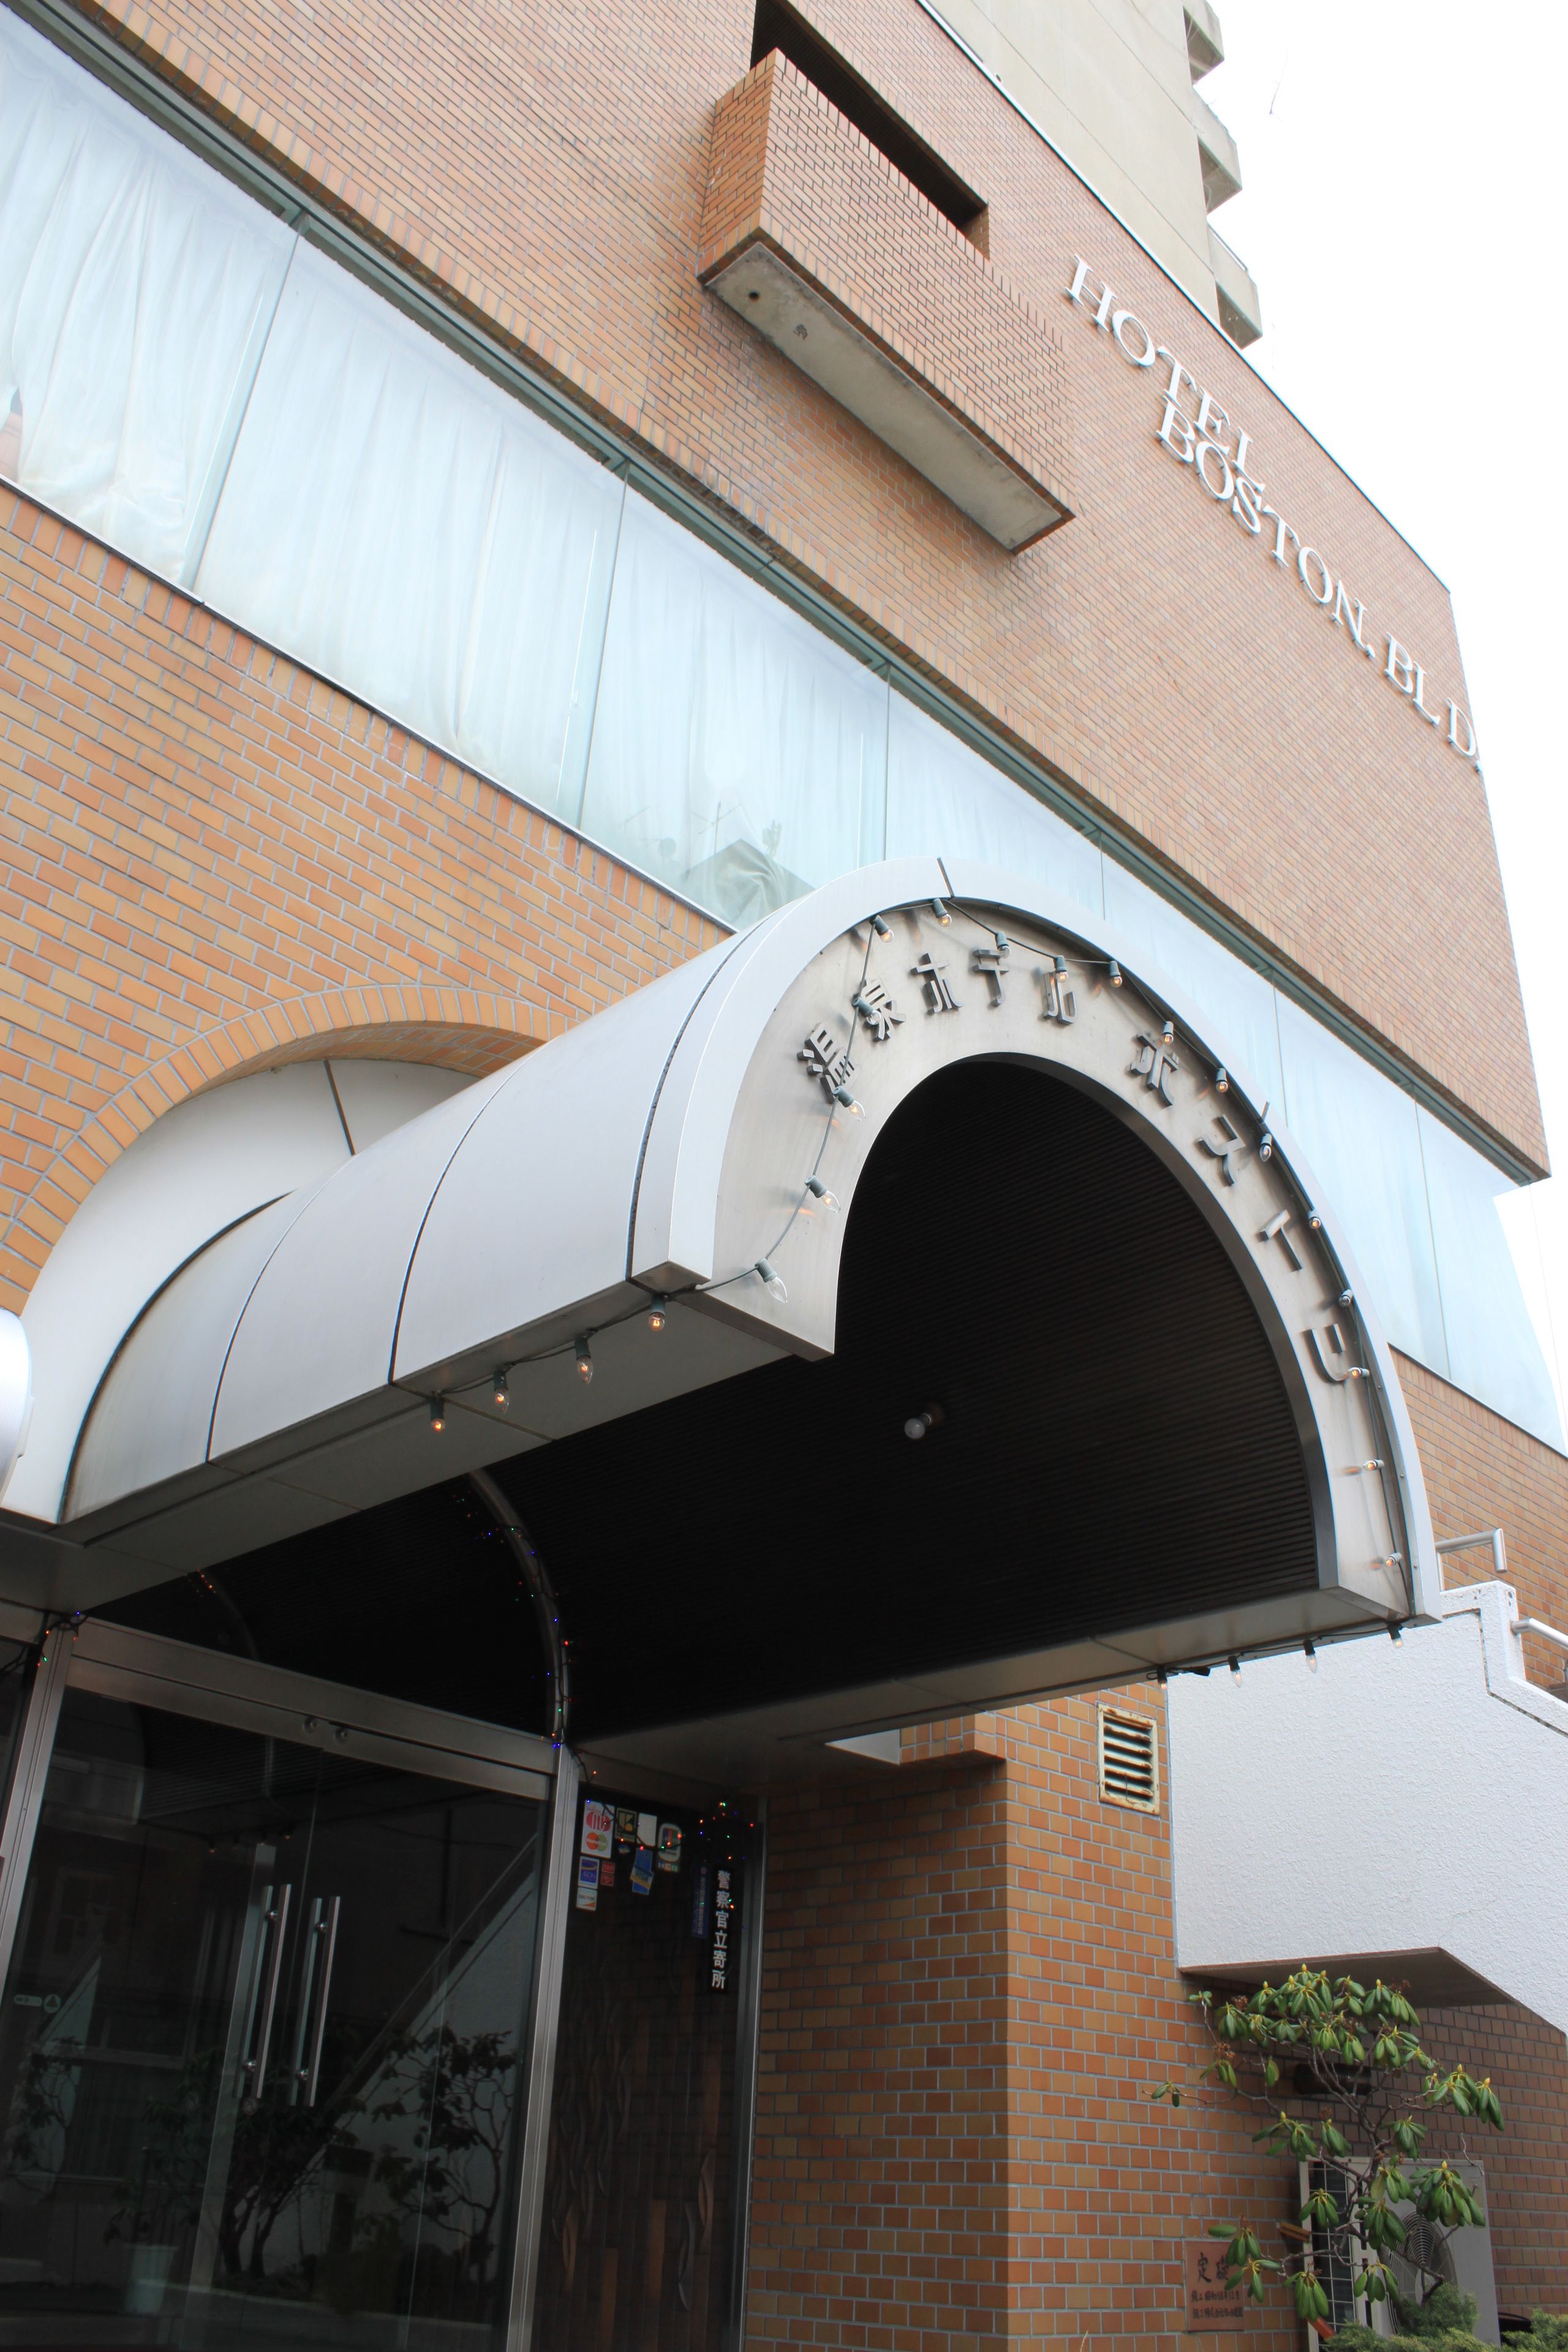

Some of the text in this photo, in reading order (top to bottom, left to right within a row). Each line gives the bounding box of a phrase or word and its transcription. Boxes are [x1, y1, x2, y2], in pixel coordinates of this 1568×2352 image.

[1065, 253, 1266, 494] HOTEL
[711, 1870, 731, 1989] 警察官立寄所
